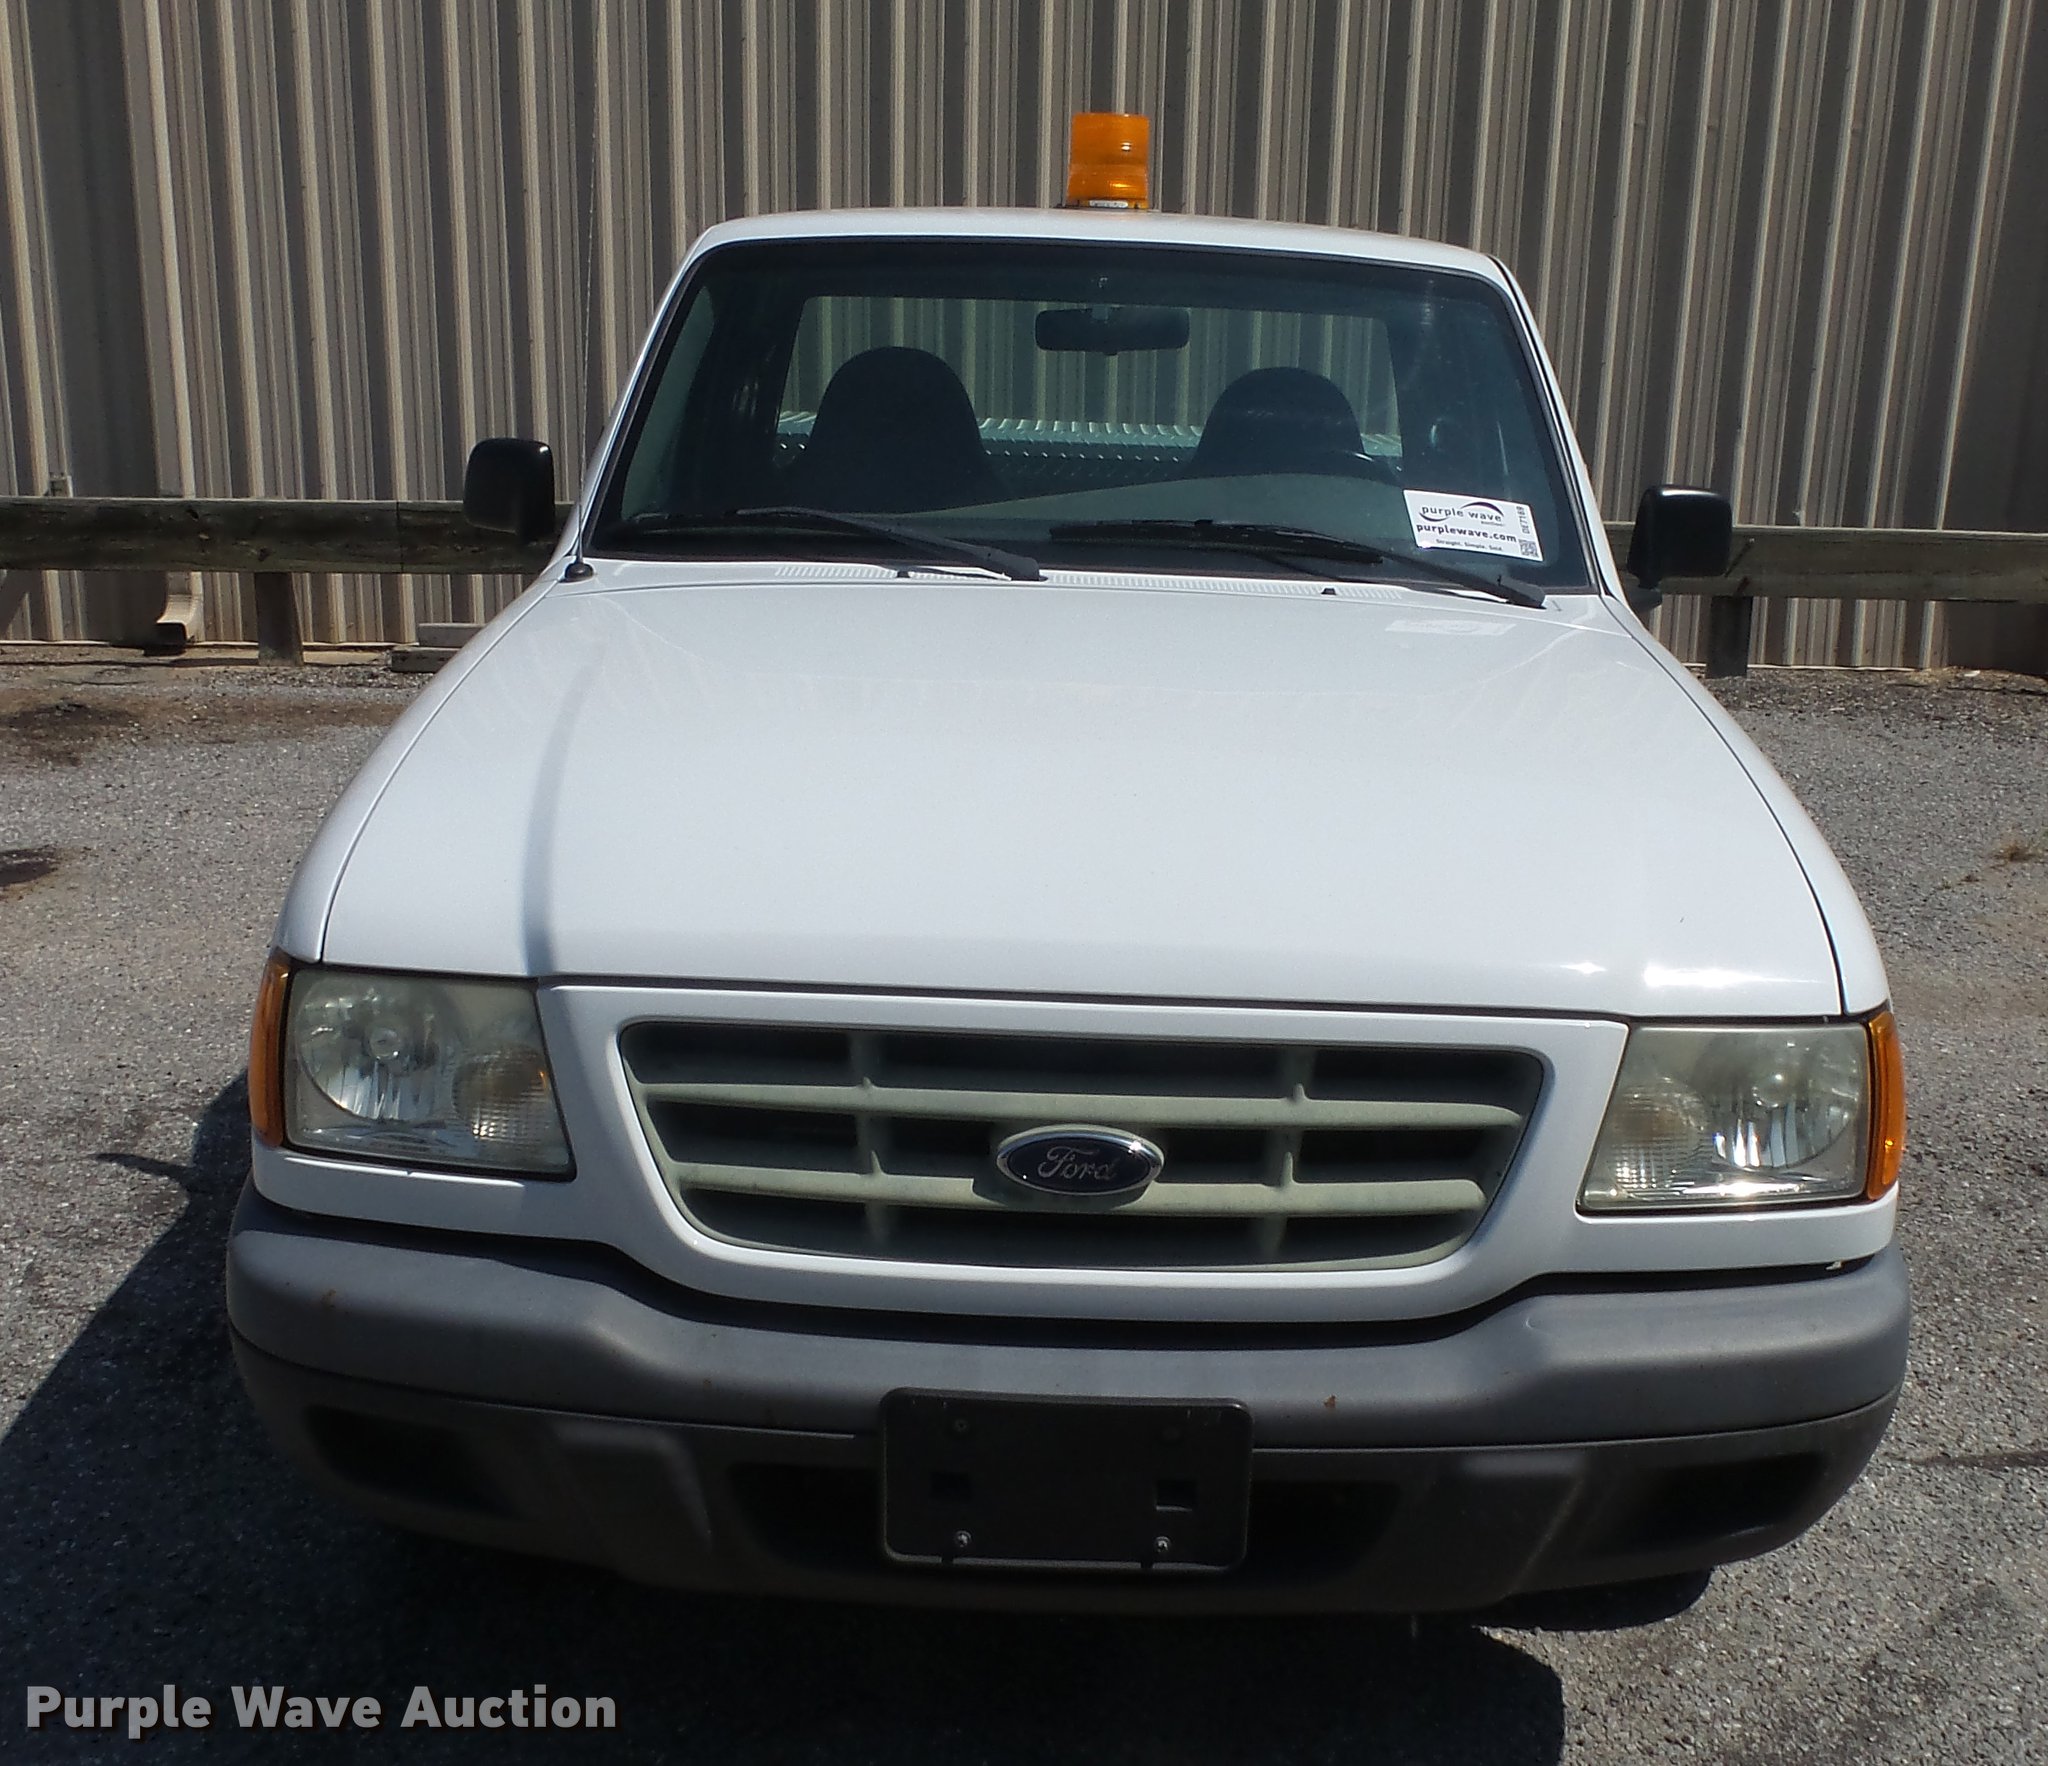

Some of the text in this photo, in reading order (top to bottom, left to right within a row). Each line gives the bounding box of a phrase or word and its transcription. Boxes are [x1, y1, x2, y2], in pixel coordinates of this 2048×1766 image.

[1421, 505, 1502, 522] purple wave
[1416, 524, 1517, 543] purplewave.com
[1037, 1146, 1120, 1180] Ford
